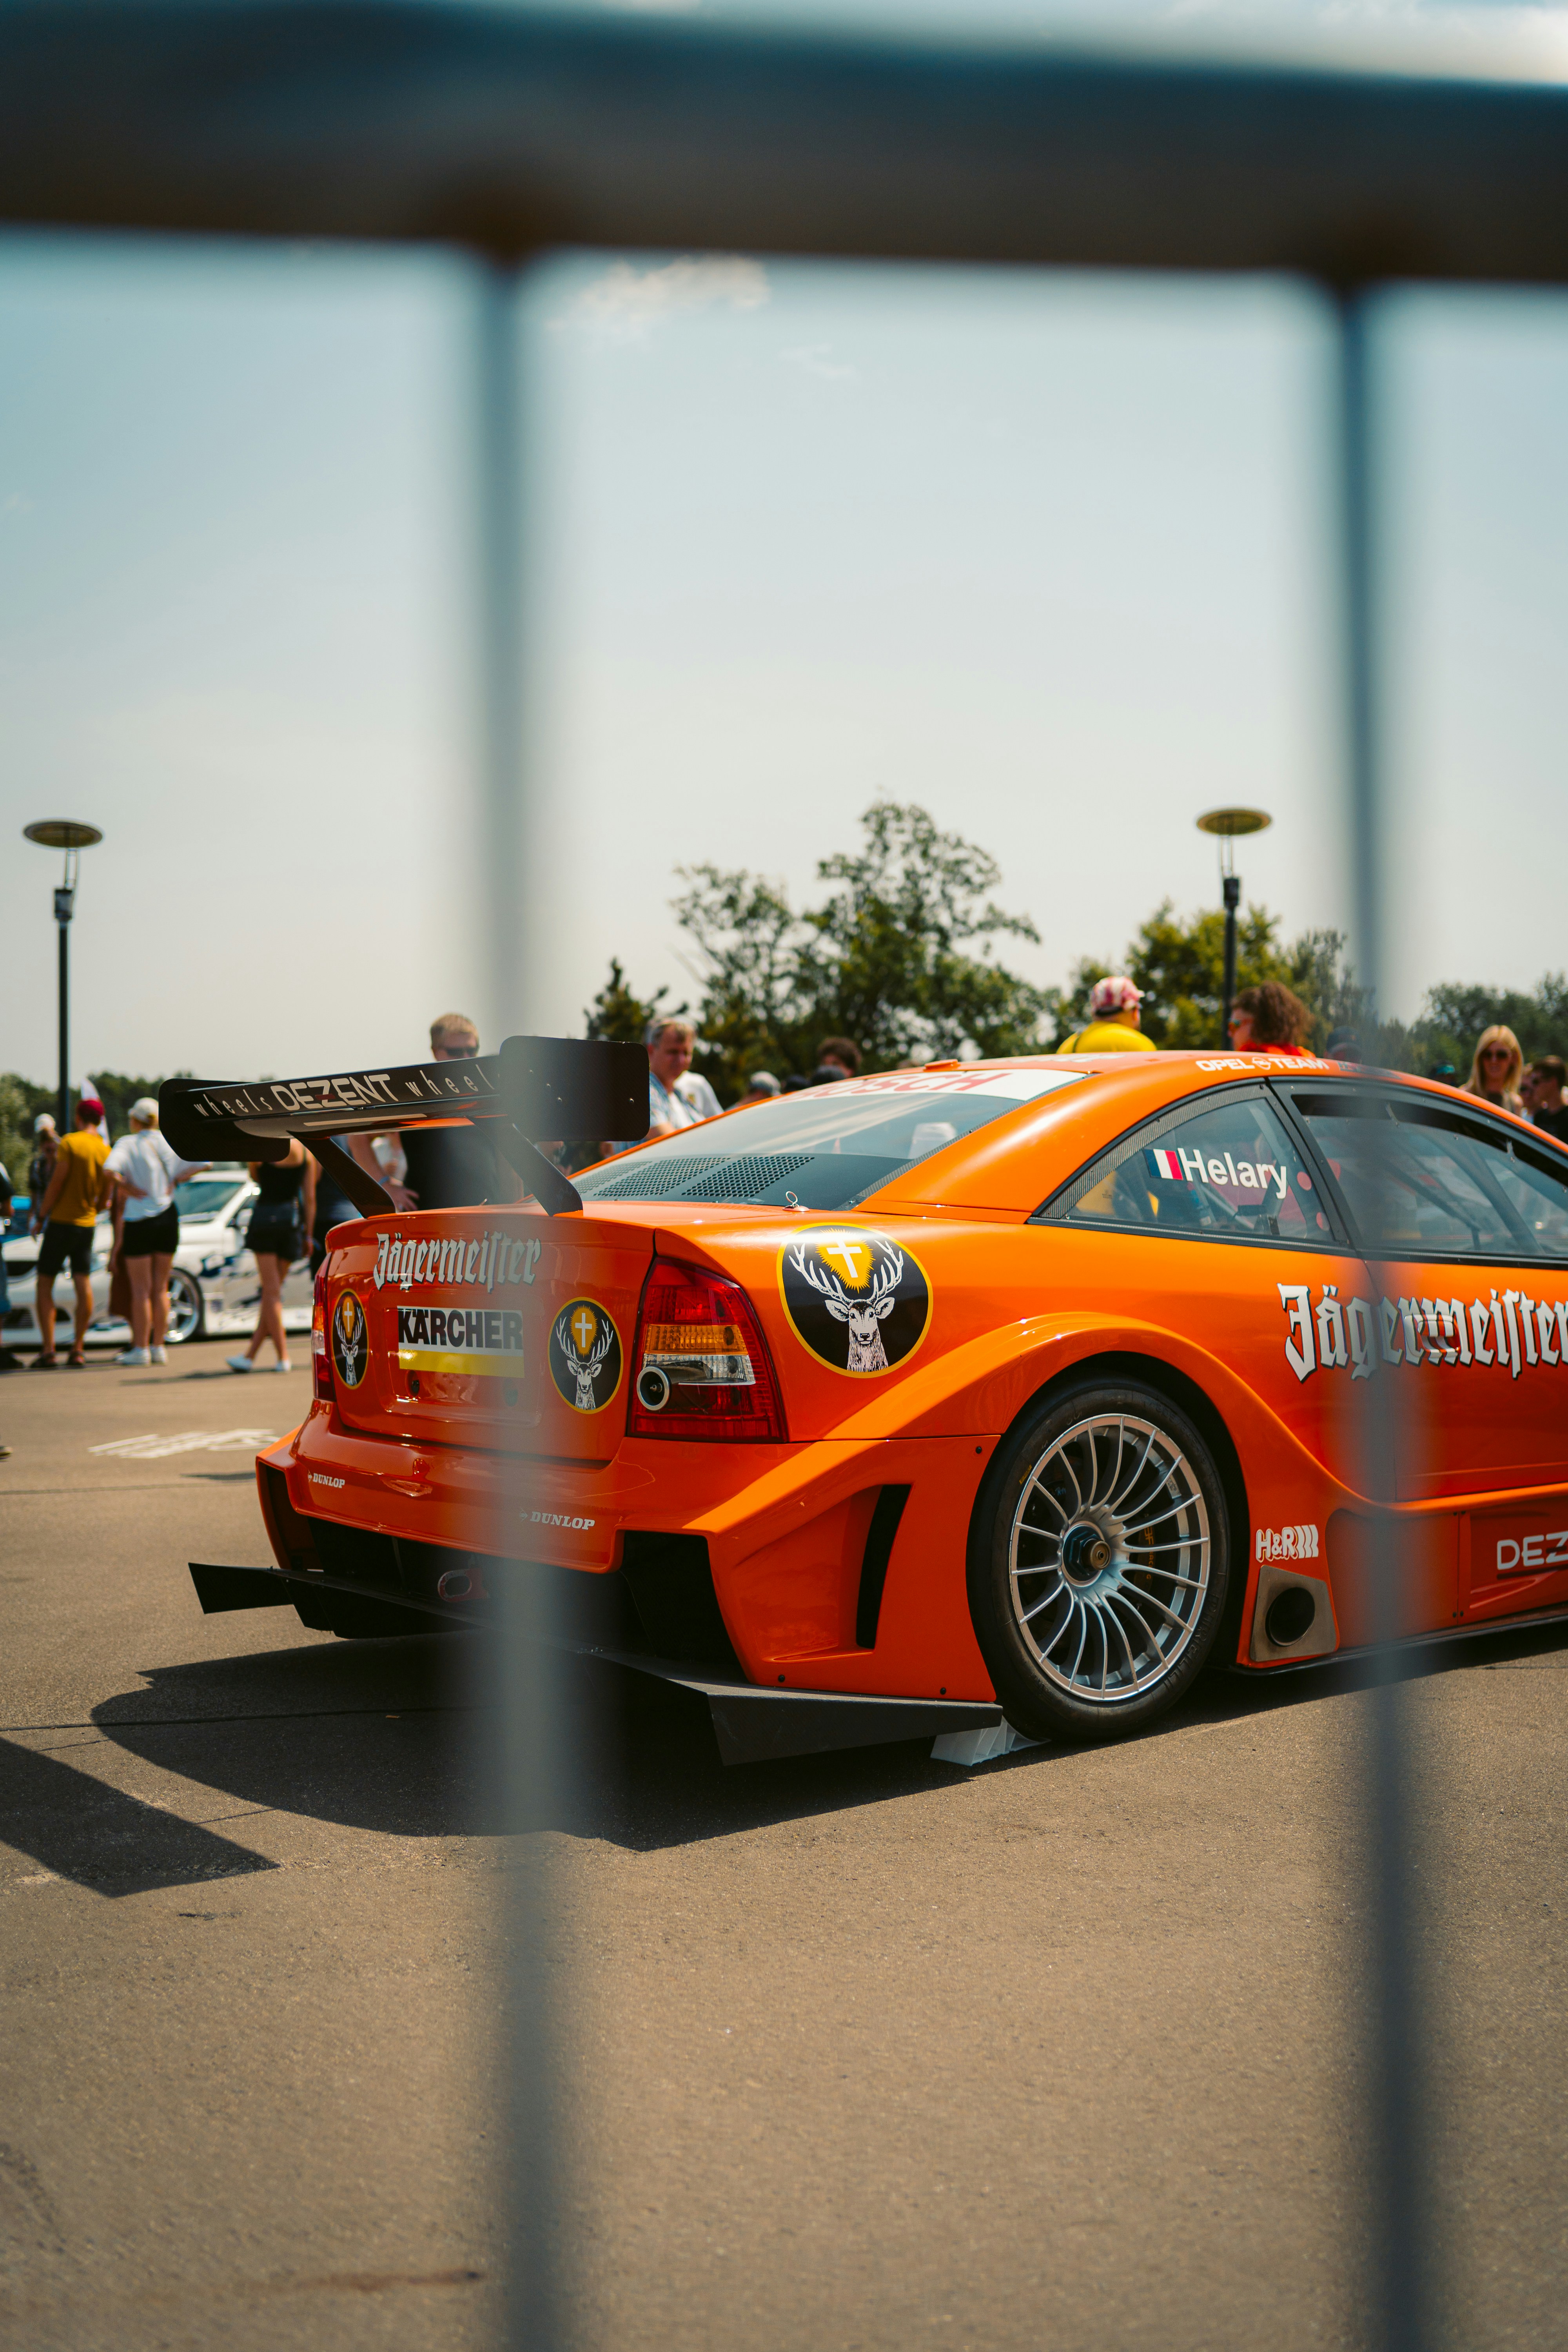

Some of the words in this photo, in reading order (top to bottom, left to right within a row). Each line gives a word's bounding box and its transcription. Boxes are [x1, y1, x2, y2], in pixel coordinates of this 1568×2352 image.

[1196, 1058, 1255, 1071] OPEL
[1268, 1058, 1330, 1070] TEAM
[194, 1089, 273, 1117] wheels
[270, 1074, 399, 1111] DEZENT
[405, 1064, 500, 1097] wheel
[1178, 1147, 1287, 1200] Helary
[397, 1307, 524, 1350] KÄRCHER
[313, 1472, 345, 1488] DUNLOP
[530, 1511, 595, 1530] DUNLOP
[1163, 1593, 1220, 1691] PIRELLI
